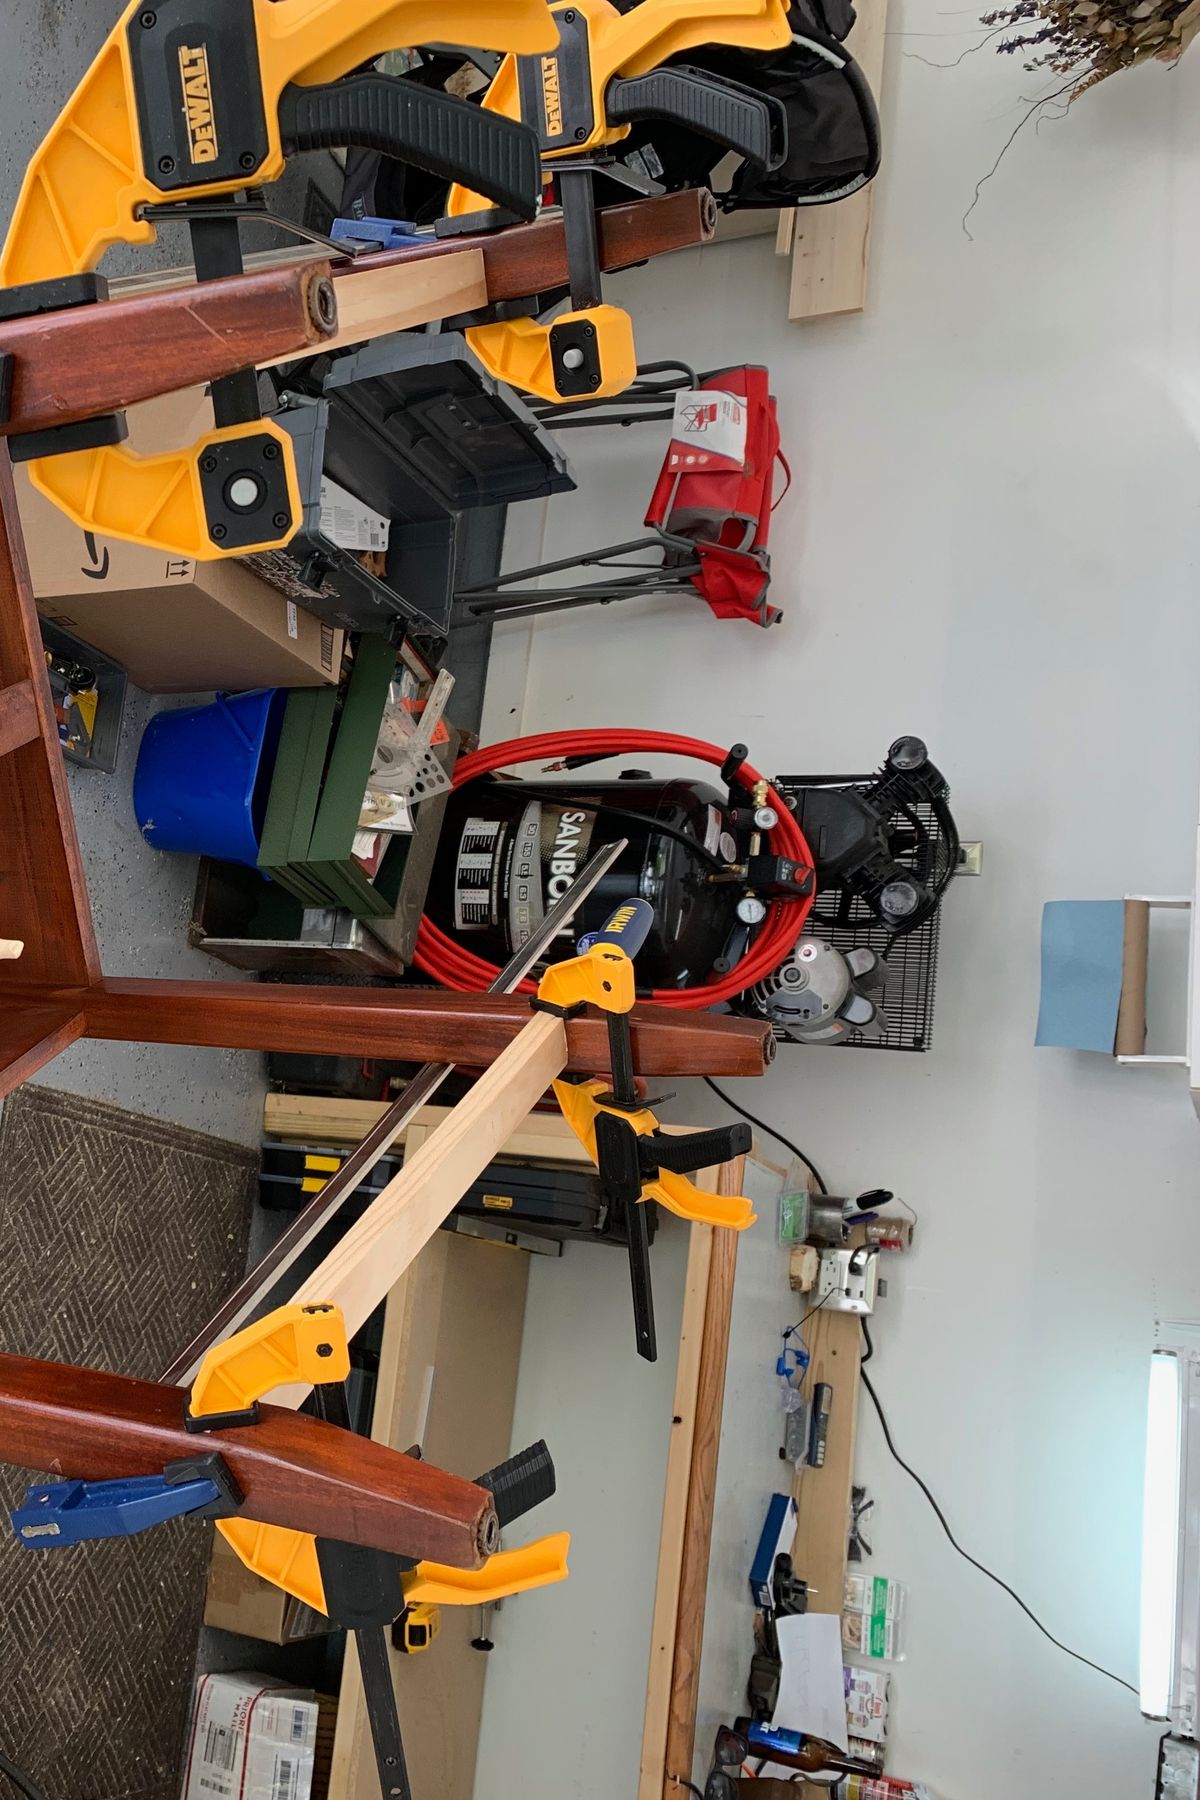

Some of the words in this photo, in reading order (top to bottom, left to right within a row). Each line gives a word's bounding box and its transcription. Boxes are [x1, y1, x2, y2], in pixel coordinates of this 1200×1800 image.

[179, 45, 218, 164] DEWALT
[541, 56, 563, 136] DEWALT
[605, 906, 637, 933] IRWIN
[238, 1697, 253, 1731] PRIORI
